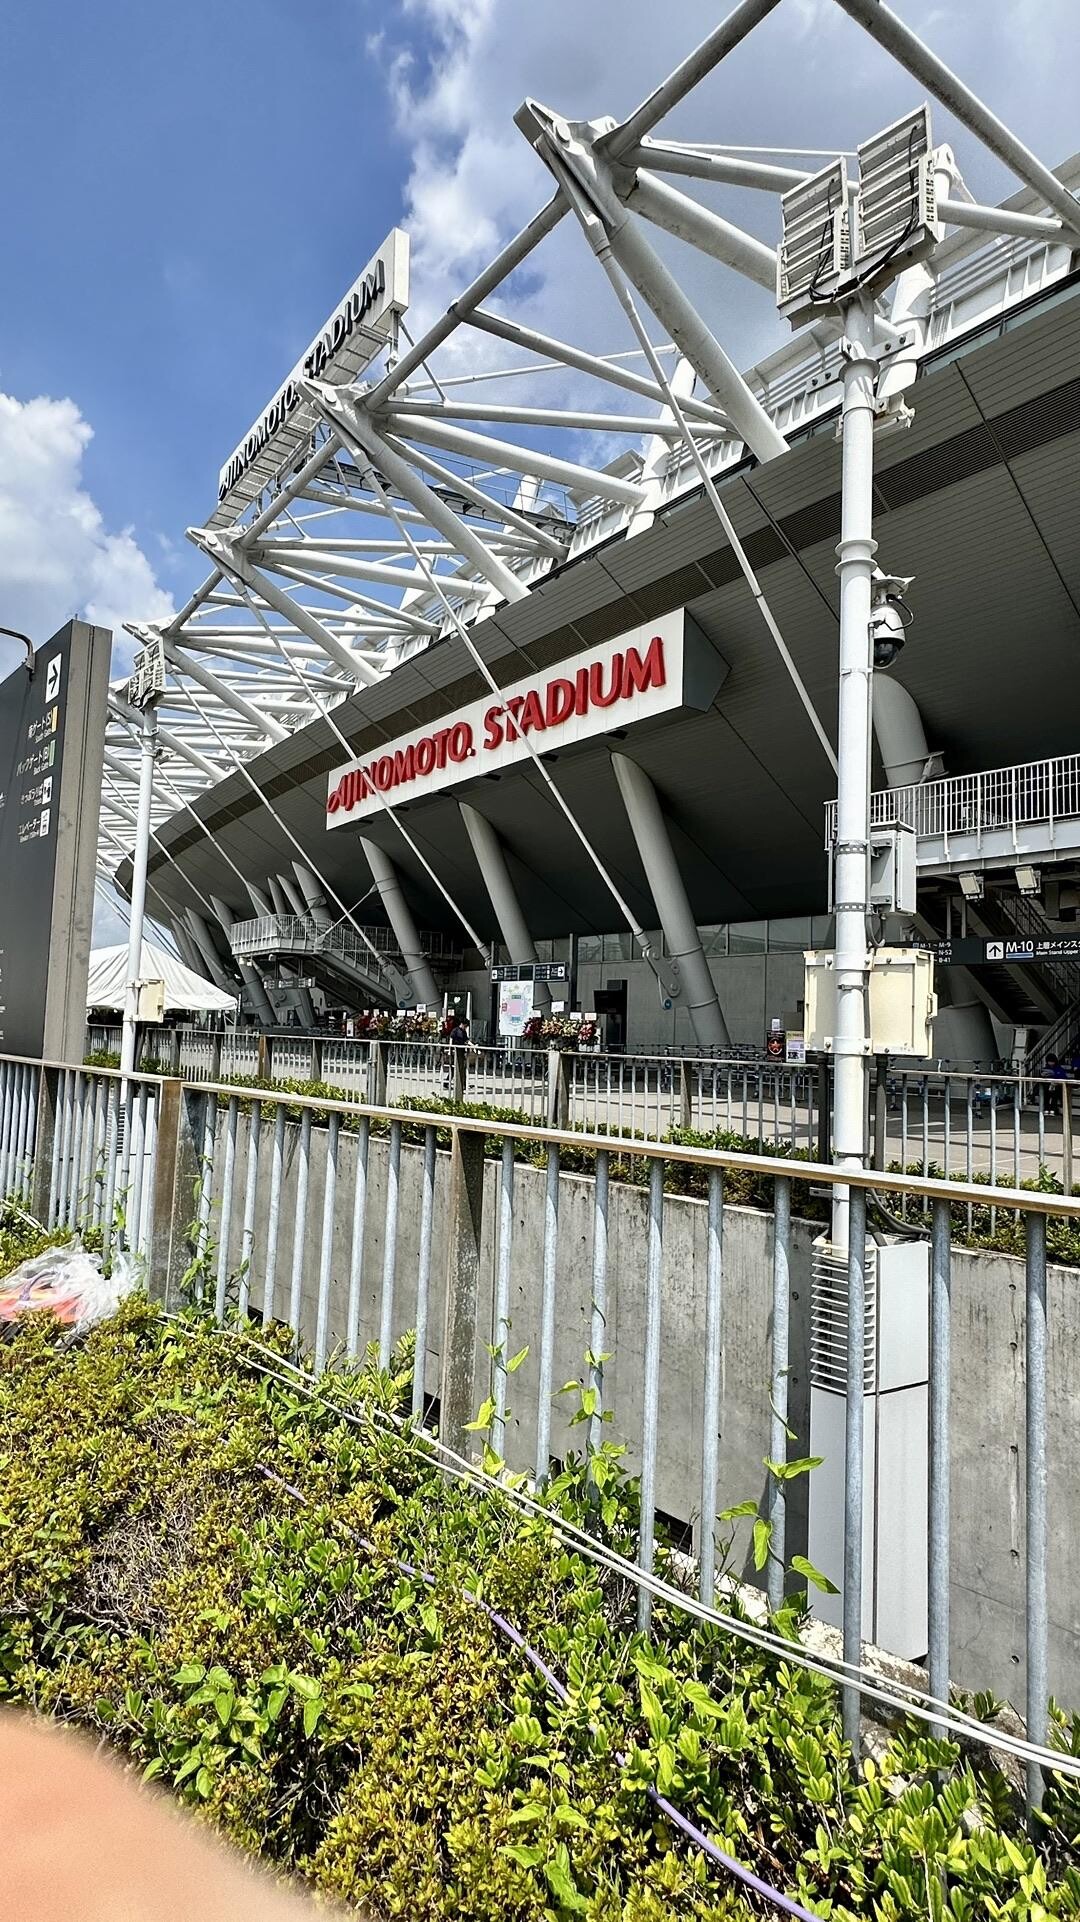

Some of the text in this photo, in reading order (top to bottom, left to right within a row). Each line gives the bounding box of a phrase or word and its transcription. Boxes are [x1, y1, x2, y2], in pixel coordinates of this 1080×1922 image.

[303, 259, 385, 379] STADIUM
[483, 636, 666, 750] STADIUM
[1005, 940, 1034, 953] M-10
